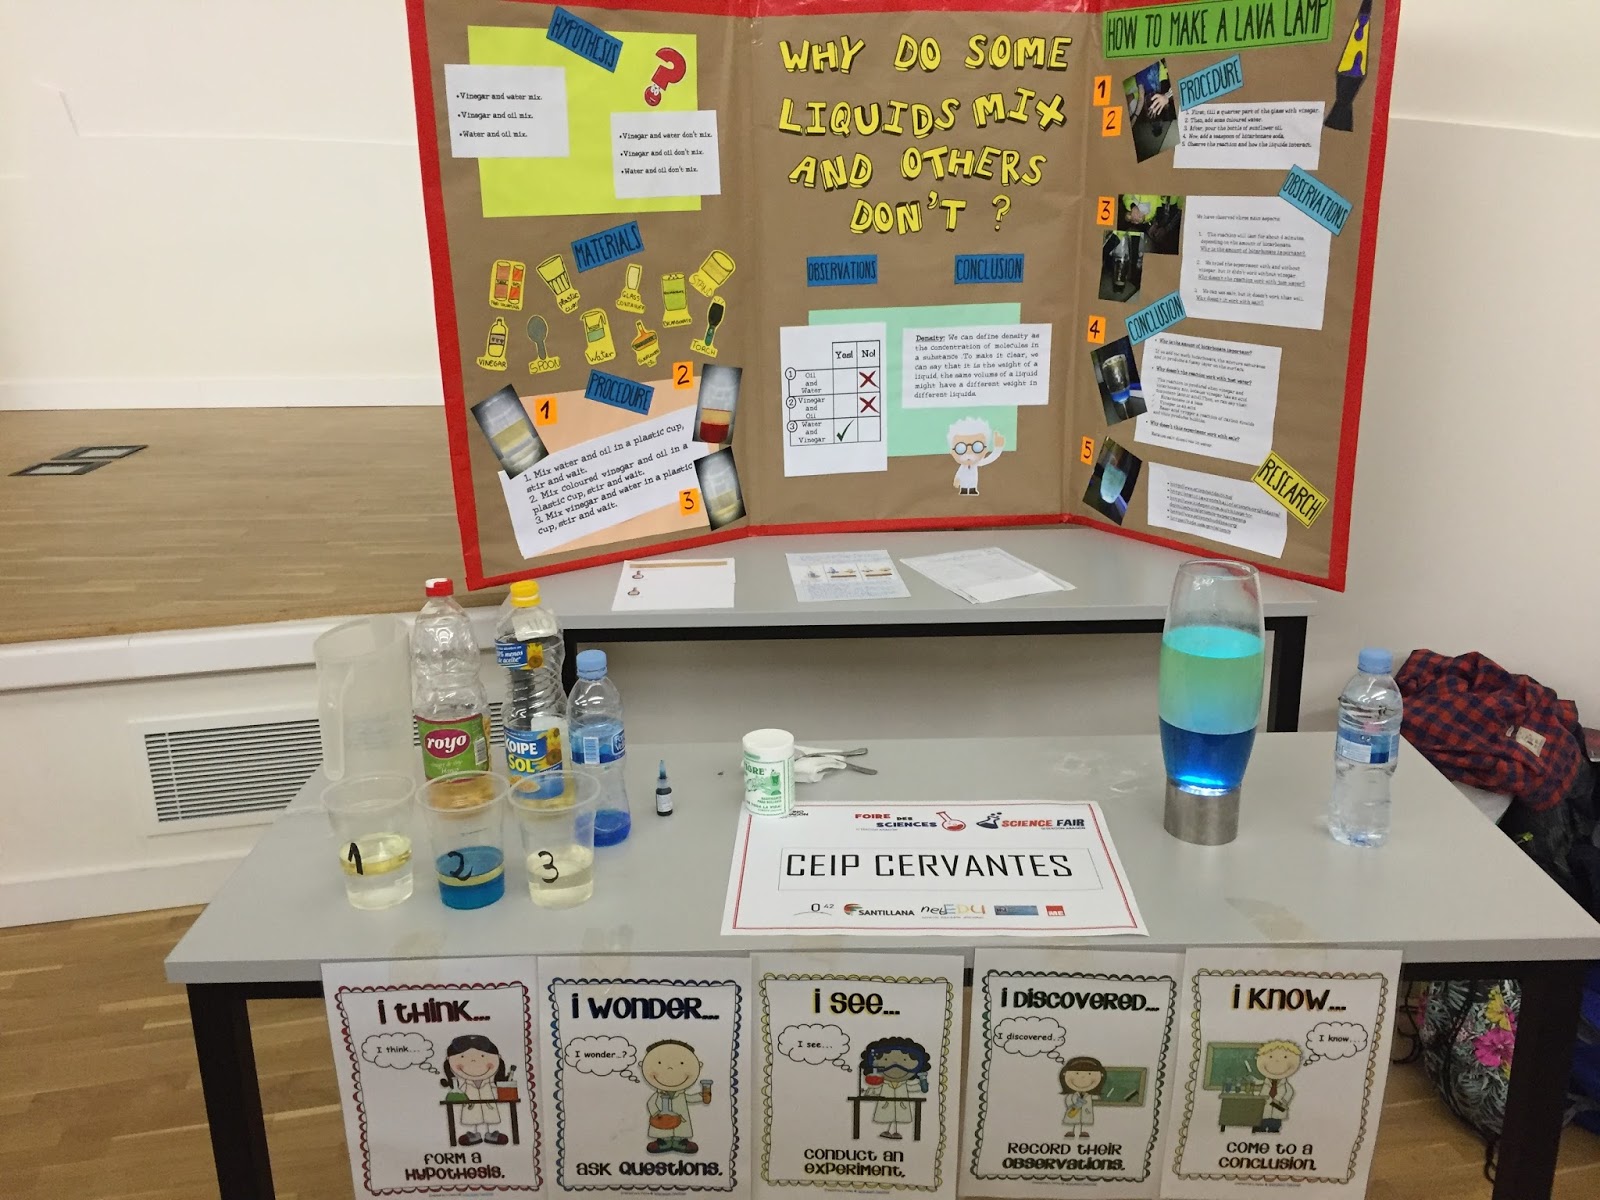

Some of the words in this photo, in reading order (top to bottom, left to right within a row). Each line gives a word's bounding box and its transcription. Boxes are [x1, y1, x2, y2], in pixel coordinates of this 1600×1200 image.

[1108, 15, 1137, 50] HOW
[1146, 14, 1161, 47] TO
[1170, 9, 1208, 46] MAKE
[1217, 8, 1227, 42] A
[1235, 2, 1274, 41] LAVA
[1284, 0, 1328, 36] LAMP
[552, 14, 620, 68] HYPOTHESIS
[779, 35, 865, 74] WHY
[894, 34, 941, 72] DO
[965, 34, 1072, 71] SOME
[1098, 80, 1105, 98] 1
[1180, 59, 1242, 106] PROCEDURE
[460, 92, 489, 101] Vinegar
[461, 112, 490, 120] Vinegar
[779, 98, 960, 138] LIQUIDS
[973, 87, 1067, 130] MIX
[1105, 110, 1116, 130] 2
[789, 152, 873, 191] AND
[901, 146, 1047, 186] OTHERS
[1101, 200, 1111, 221] 3
[1282, 172, 1349, 230] OBSERVATIONS
[850, 190, 967, 235] DON'T
[992, 194, 1011, 232] ?
[576, 225, 642, 269] MATERIALS
[808, 261, 877, 281] OBSERVATIONS
[956, 258, 1022, 281] CONCLUSION
[693, 275, 713, 297] STAND
[622, 291, 640, 302] GLASS
[1128, 295, 1184, 342] CONCLUSION
[1089, 320, 1100, 339] 4
[588, 350, 614, 363] Water
[692, 341, 716, 356] TORCH
[835, 350, 853, 359] Yes!
[862, 349, 876, 358] No!
[478, 358, 508, 368] VINEGAR
[530, 359, 560, 373] SPOON
[677, 366, 690, 386] 2
[589, 374, 651, 412] PROCEDURE
[540, 400, 550, 420] 1
[534, 467, 551, 479] Mix
[554, 459, 578, 472] water
[581, 451, 597, 462] and
[600, 445, 612, 456] oil
[614, 442, 623, 452] in
[634, 428, 664, 446] plastic
[666, 423, 684, 434] cup,
[1084, 441, 1092, 459] 5
[527, 482, 545, 493] stir
[548, 475, 564, 486] and
[566, 468, 588, 479] wait.
[1258, 458, 1322, 521] RESEARCH
[532, 497, 565, 516] plastic
[567, 491, 586, 502] cup,
[587, 484, 605, 494] stir
[607, 477, 622, 488] and
[624, 470, 645, 481] wait.
[683, 492, 694, 510] 3
[427, 735, 467, 753] royo
[506, 738, 538, 755] KOIPE
[508, 754, 536, 773] SOL
[1002, 819, 1053, 828] SCIENCE
[1056, 818, 1085, 827] FAIR
[348, 842, 364, 876] 1
[447, 851, 474, 881] 2
[538, 851, 560, 883] 3
[786, 854, 860, 877] CEIP
[876, 854, 1074, 877] CERVANTES
[1007, 1033, 1064, 1042] discovered...
[1328, 1034, 1360, 1043] know...
